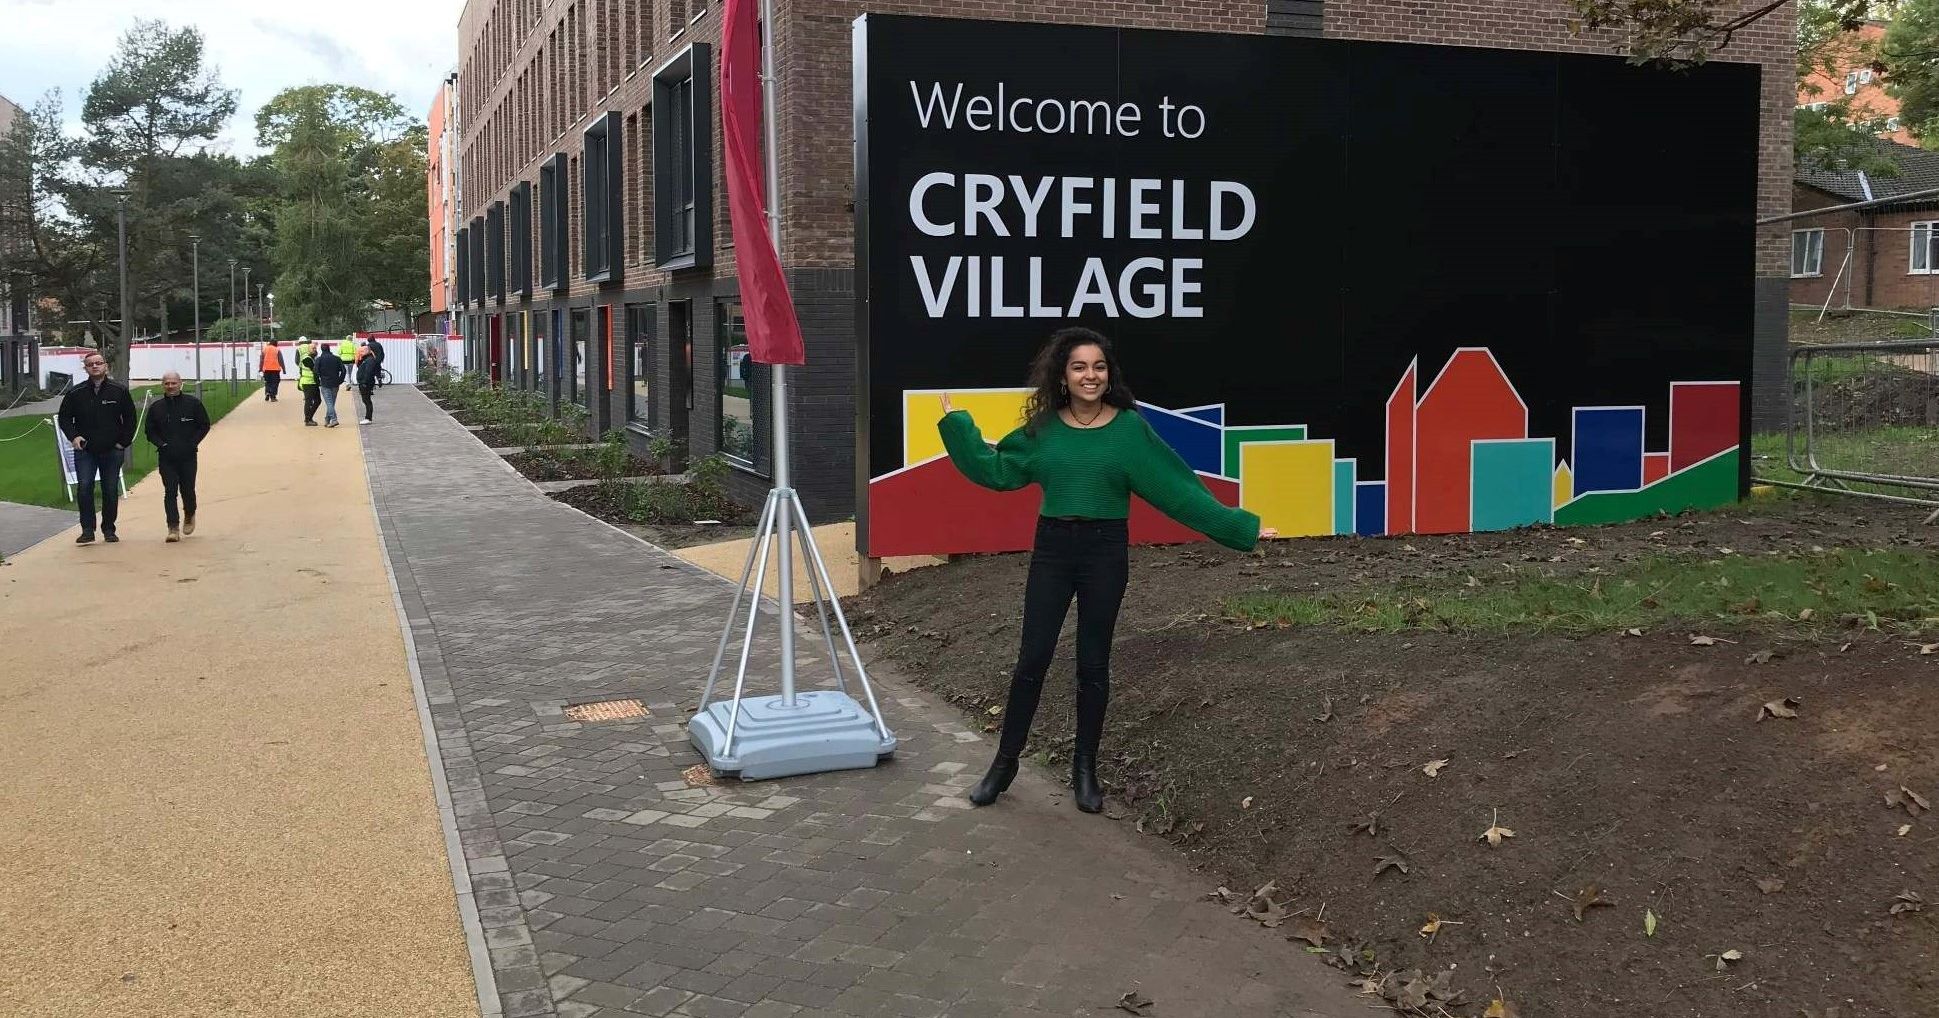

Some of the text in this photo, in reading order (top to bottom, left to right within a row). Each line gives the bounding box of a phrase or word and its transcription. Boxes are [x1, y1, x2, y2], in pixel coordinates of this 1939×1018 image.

[909, 80, 1206, 139] Welcome to
[909, 171, 1256, 241] CRYFIELD
[909, 255, 1204, 319] VILLAGE
